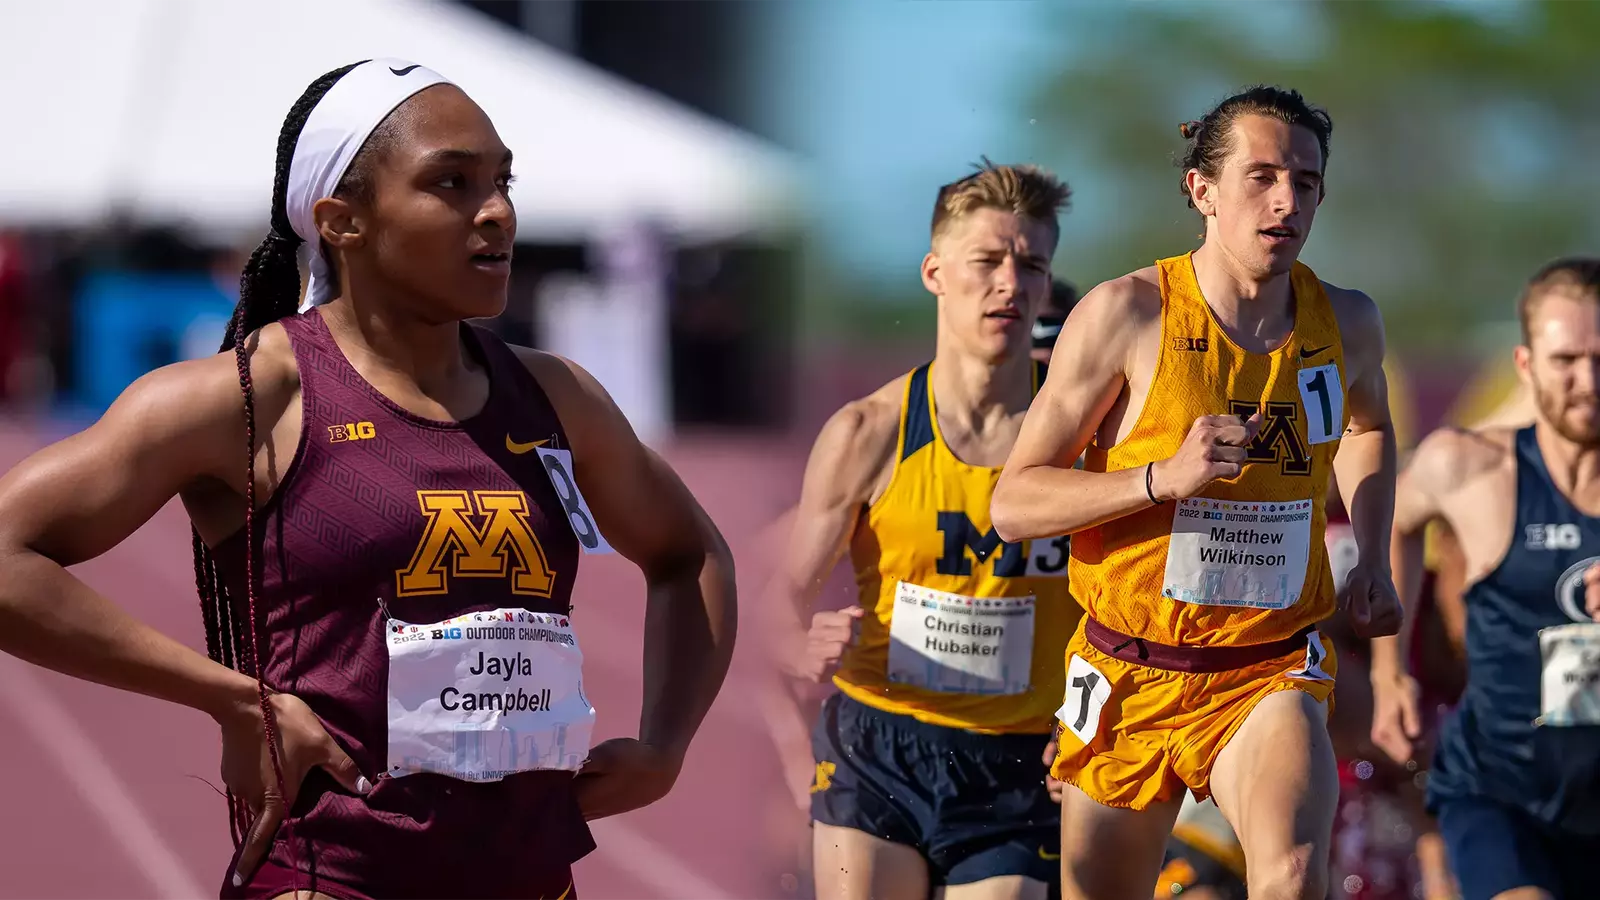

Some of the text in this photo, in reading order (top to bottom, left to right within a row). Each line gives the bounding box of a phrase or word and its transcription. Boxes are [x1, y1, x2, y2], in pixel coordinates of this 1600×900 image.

[1306, 370, 1333, 437] 1
[542, 454, 599, 549] 8
[1179, 508, 1200, 518] 2022
[1225, 513, 1258, 523] OUTDOOR
[1260, 512, 1309, 523] CHAMPIONSHIPS
[395, 490, 557, 599] M
[936, 510, 1028, 577] M
[1210, 527, 1284, 544] Matthew
[1200, 547, 1286, 566] Wilkinson
[393, 632, 426, 644] 2022
[466, 627, 515, 640] OUTDOOR
[519, 628, 574, 645] CHAMPIONSHIPS
[924, 615, 1004, 637] Christian
[925, 636, 1000, 656] Hubaker
[469, 652, 532, 681] Jayla
[440, 687, 551, 716] Campbell
[1072, 671, 1100, 732] 1
